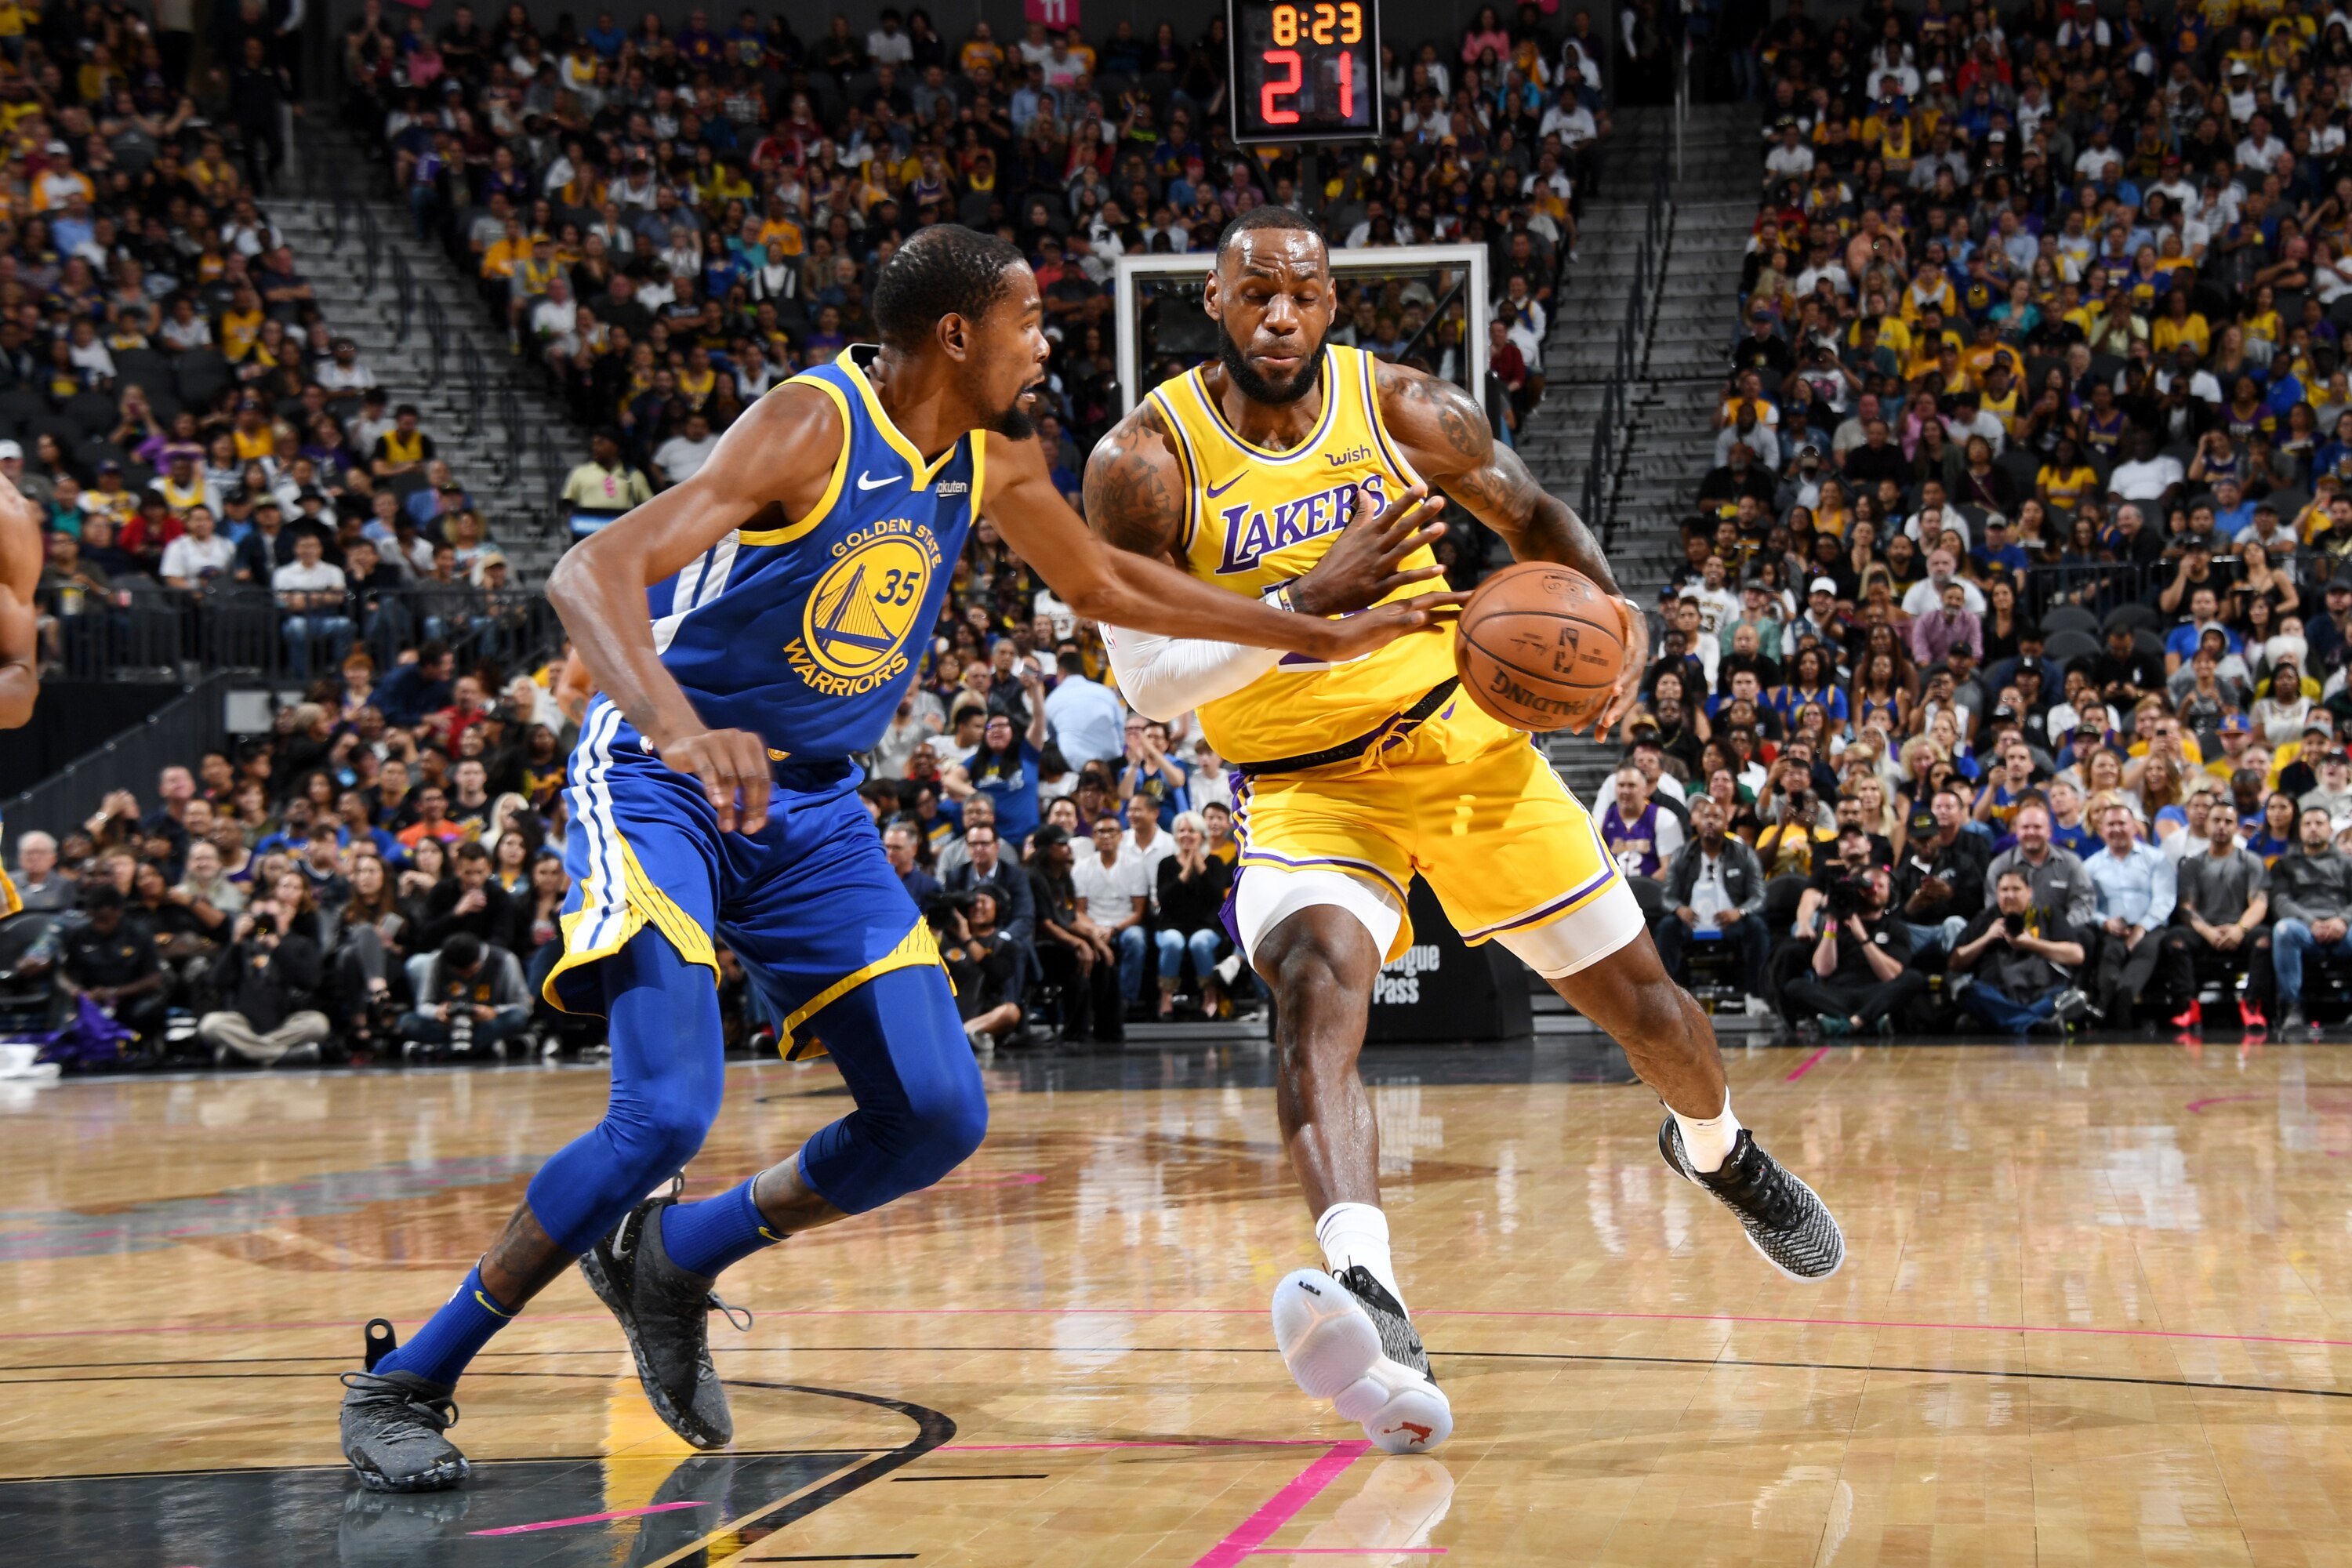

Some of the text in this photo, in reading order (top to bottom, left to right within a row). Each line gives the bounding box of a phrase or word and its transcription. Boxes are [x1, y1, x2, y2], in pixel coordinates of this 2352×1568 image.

[1040, 0, 1066, 23] 11
[1272, 2, 1362, 46] 8:23
[1261, 50, 1352, 124] 21
[1324, 444, 1371, 466] wish
[935, 480, 967, 493] akuten
[831, 518, 942, 569] GOLDEN STATE
[1214, 474, 1388, 575] LAKERS
[874, 568, 921, 606] 35
[783, 637, 909, 696] WARRIORS
[1374, 972, 1420, 1004] Pass
